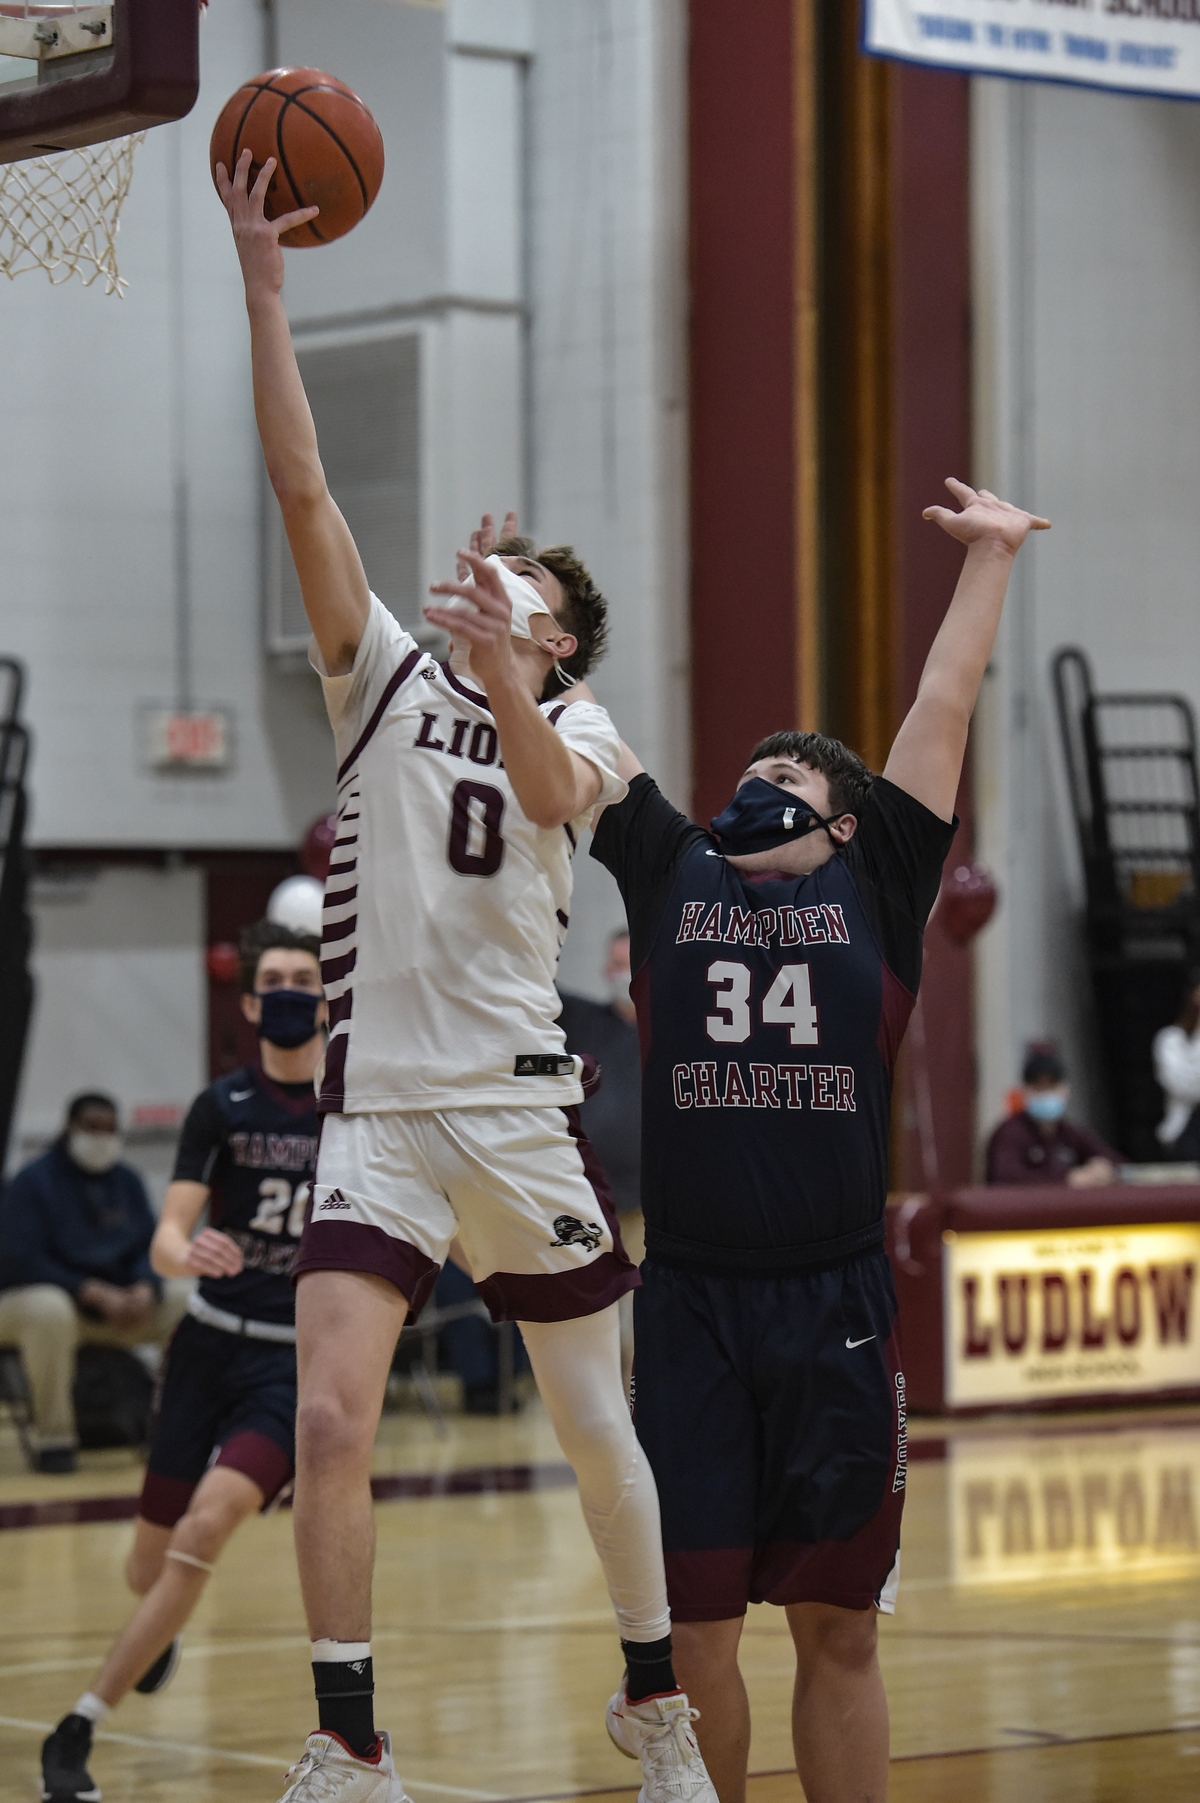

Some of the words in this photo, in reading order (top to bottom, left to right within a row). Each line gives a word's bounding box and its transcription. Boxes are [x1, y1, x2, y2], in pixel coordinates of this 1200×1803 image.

[413, 711, 506, 769] LIO
[447, 778, 506, 879] 0
[675, 901, 851, 950] HAMPDEN
[705, 959, 820, 1046] 34
[672, 1061, 857, 1112] CHARTER
[960, 1262, 1195, 1360] LUDLOW
